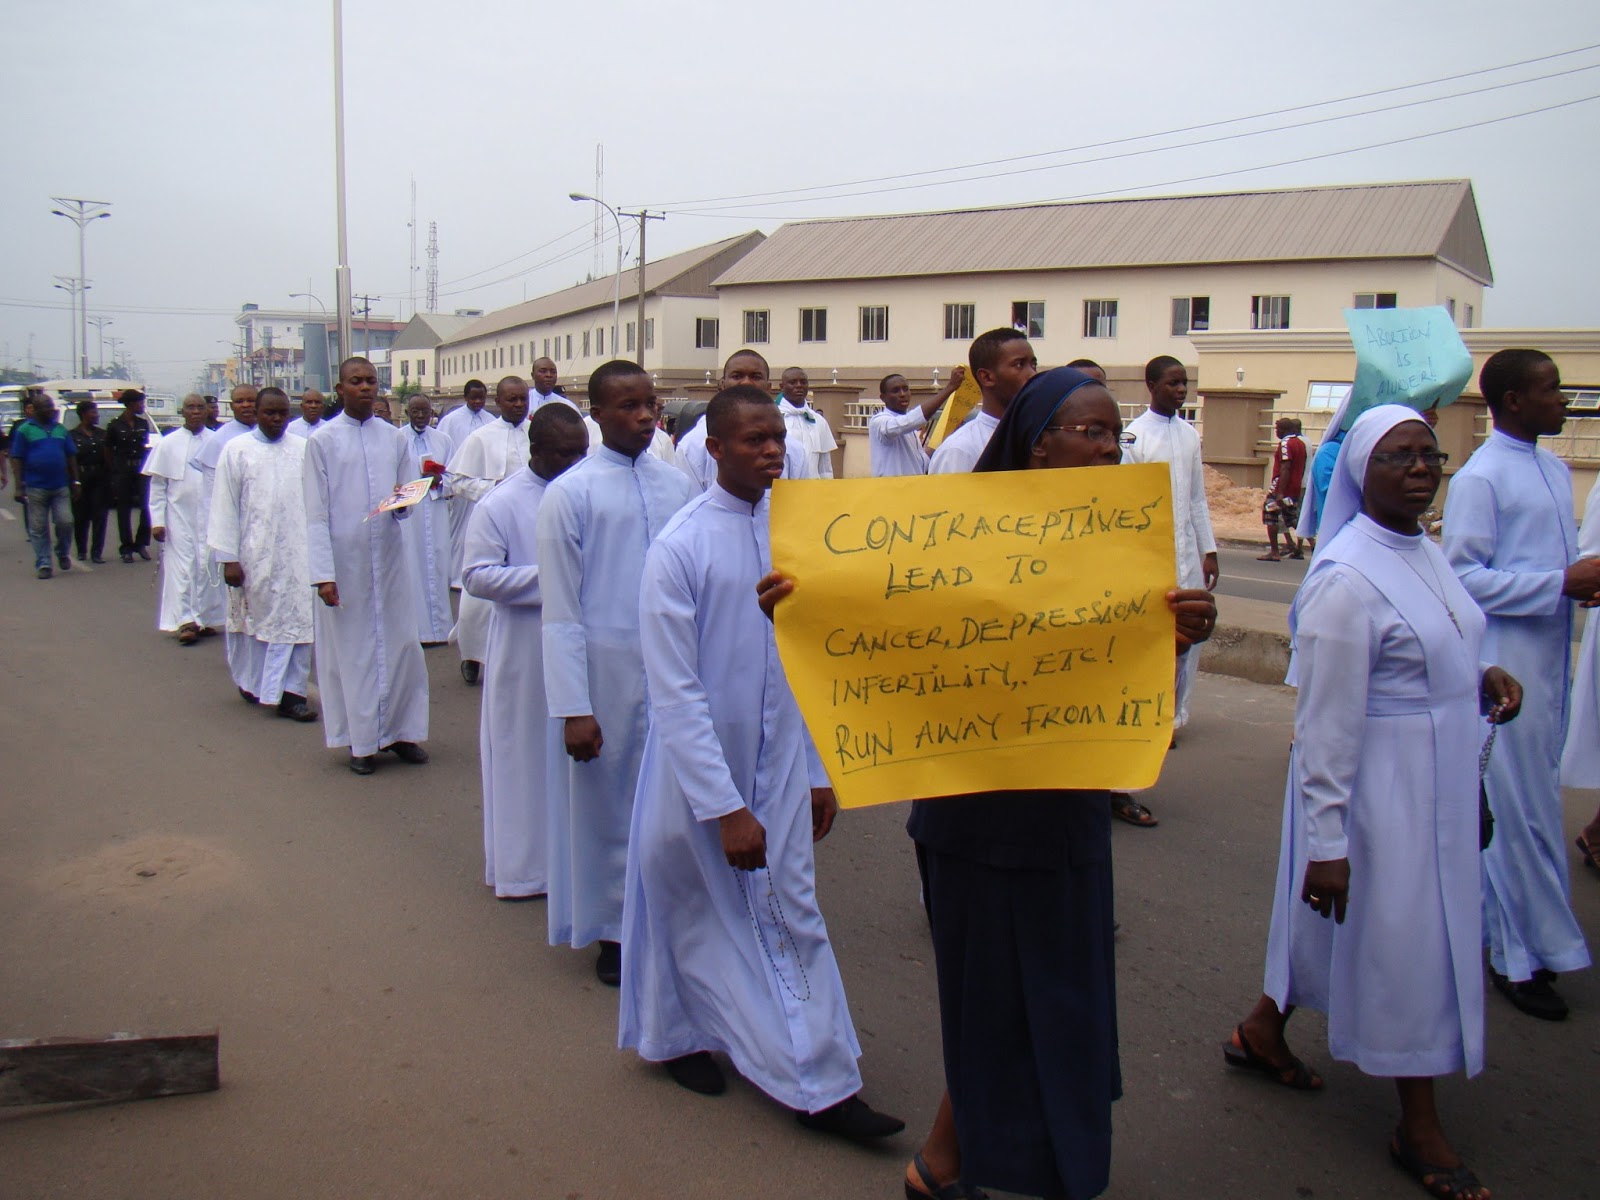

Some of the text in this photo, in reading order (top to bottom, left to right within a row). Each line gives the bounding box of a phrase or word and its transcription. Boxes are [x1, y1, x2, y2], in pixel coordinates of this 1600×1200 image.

[824, 496, 1163, 555] CONTRACEPTIVES
[884, 554, 1048, 600] LEAD TO
[1033, 635, 1116, 678] ETC!
[835, 685, 1166, 766] RUN AWAY FROM IT!
